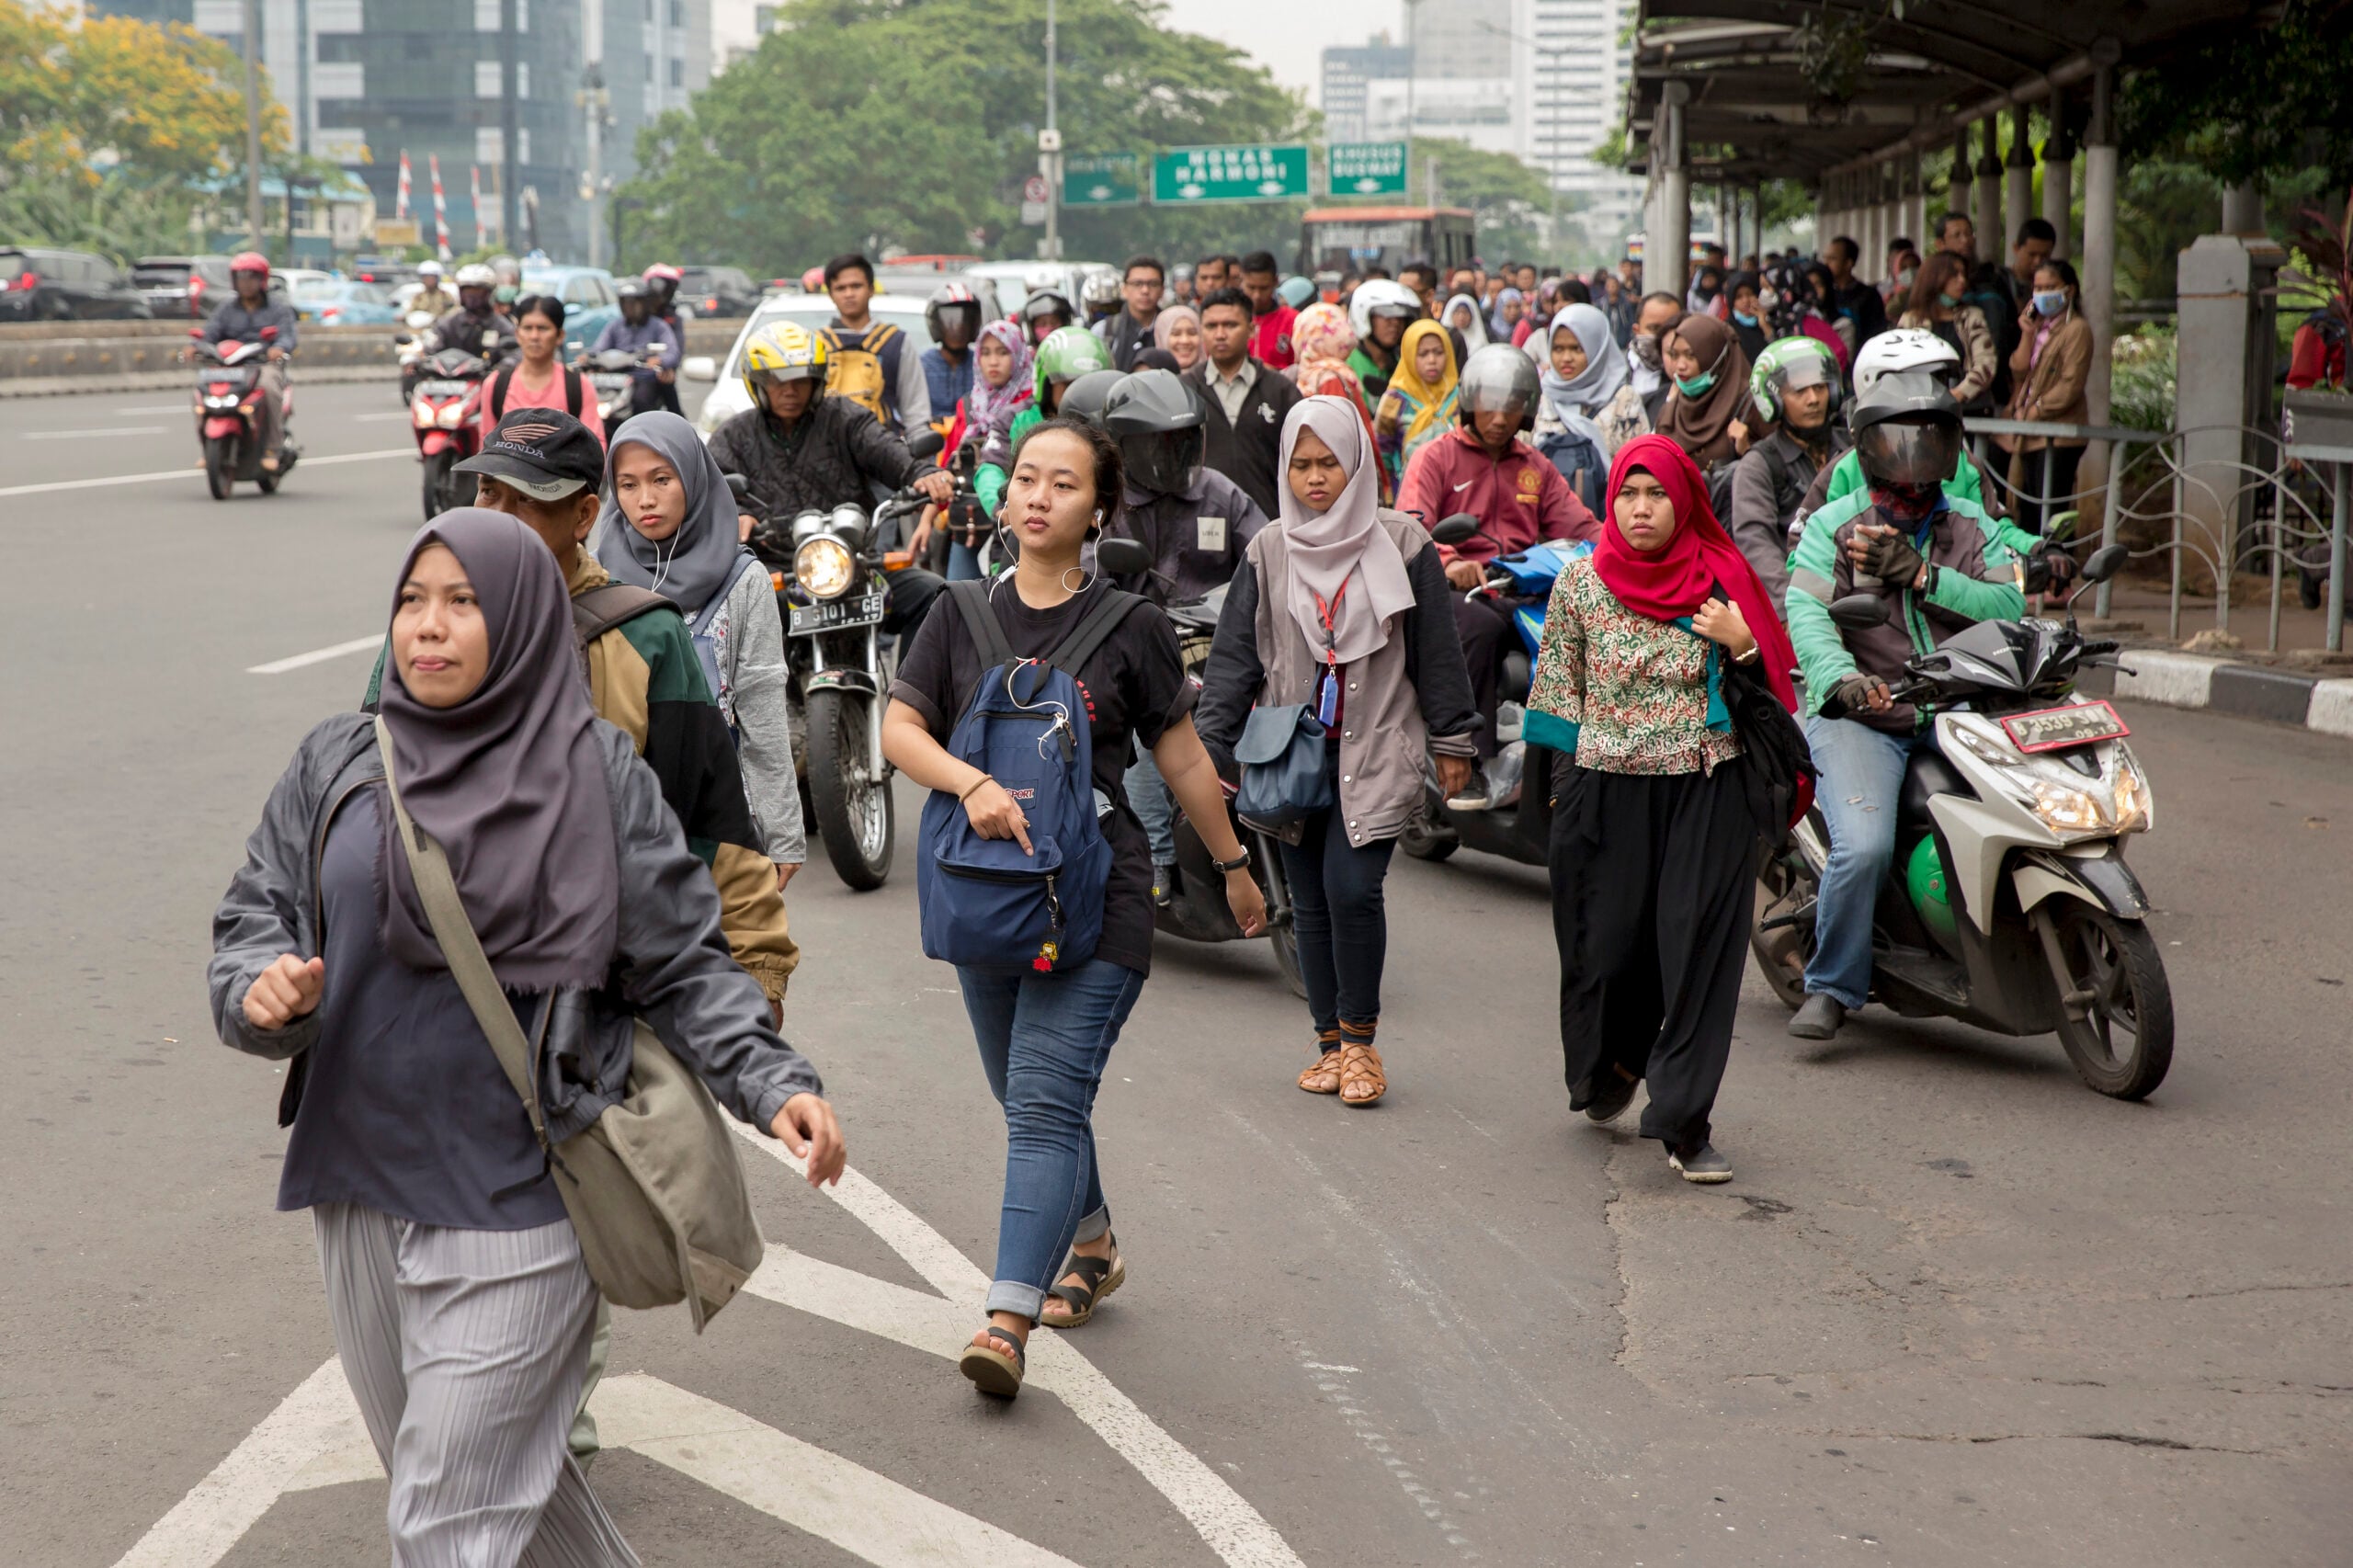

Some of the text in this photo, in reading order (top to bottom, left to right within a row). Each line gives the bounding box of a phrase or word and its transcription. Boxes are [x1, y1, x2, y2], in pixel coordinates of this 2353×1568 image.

[1188, 147, 1273, 166] MONAS
[1333, 144, 1403, 160] KHUSUS
[1176, 162, 1286, 183] HARMONI
[1333, 161, 1402, 177] BUSWAY
[493, 441, 546, 460] HONDA
[793, 611, 802, 626] B
[862, 596, 880, 613] GE
[1992, 646, 2024, 656] HONDA
[2012, 721, 2028, 736] B
[2029, 714, 2074, 733] 3539
